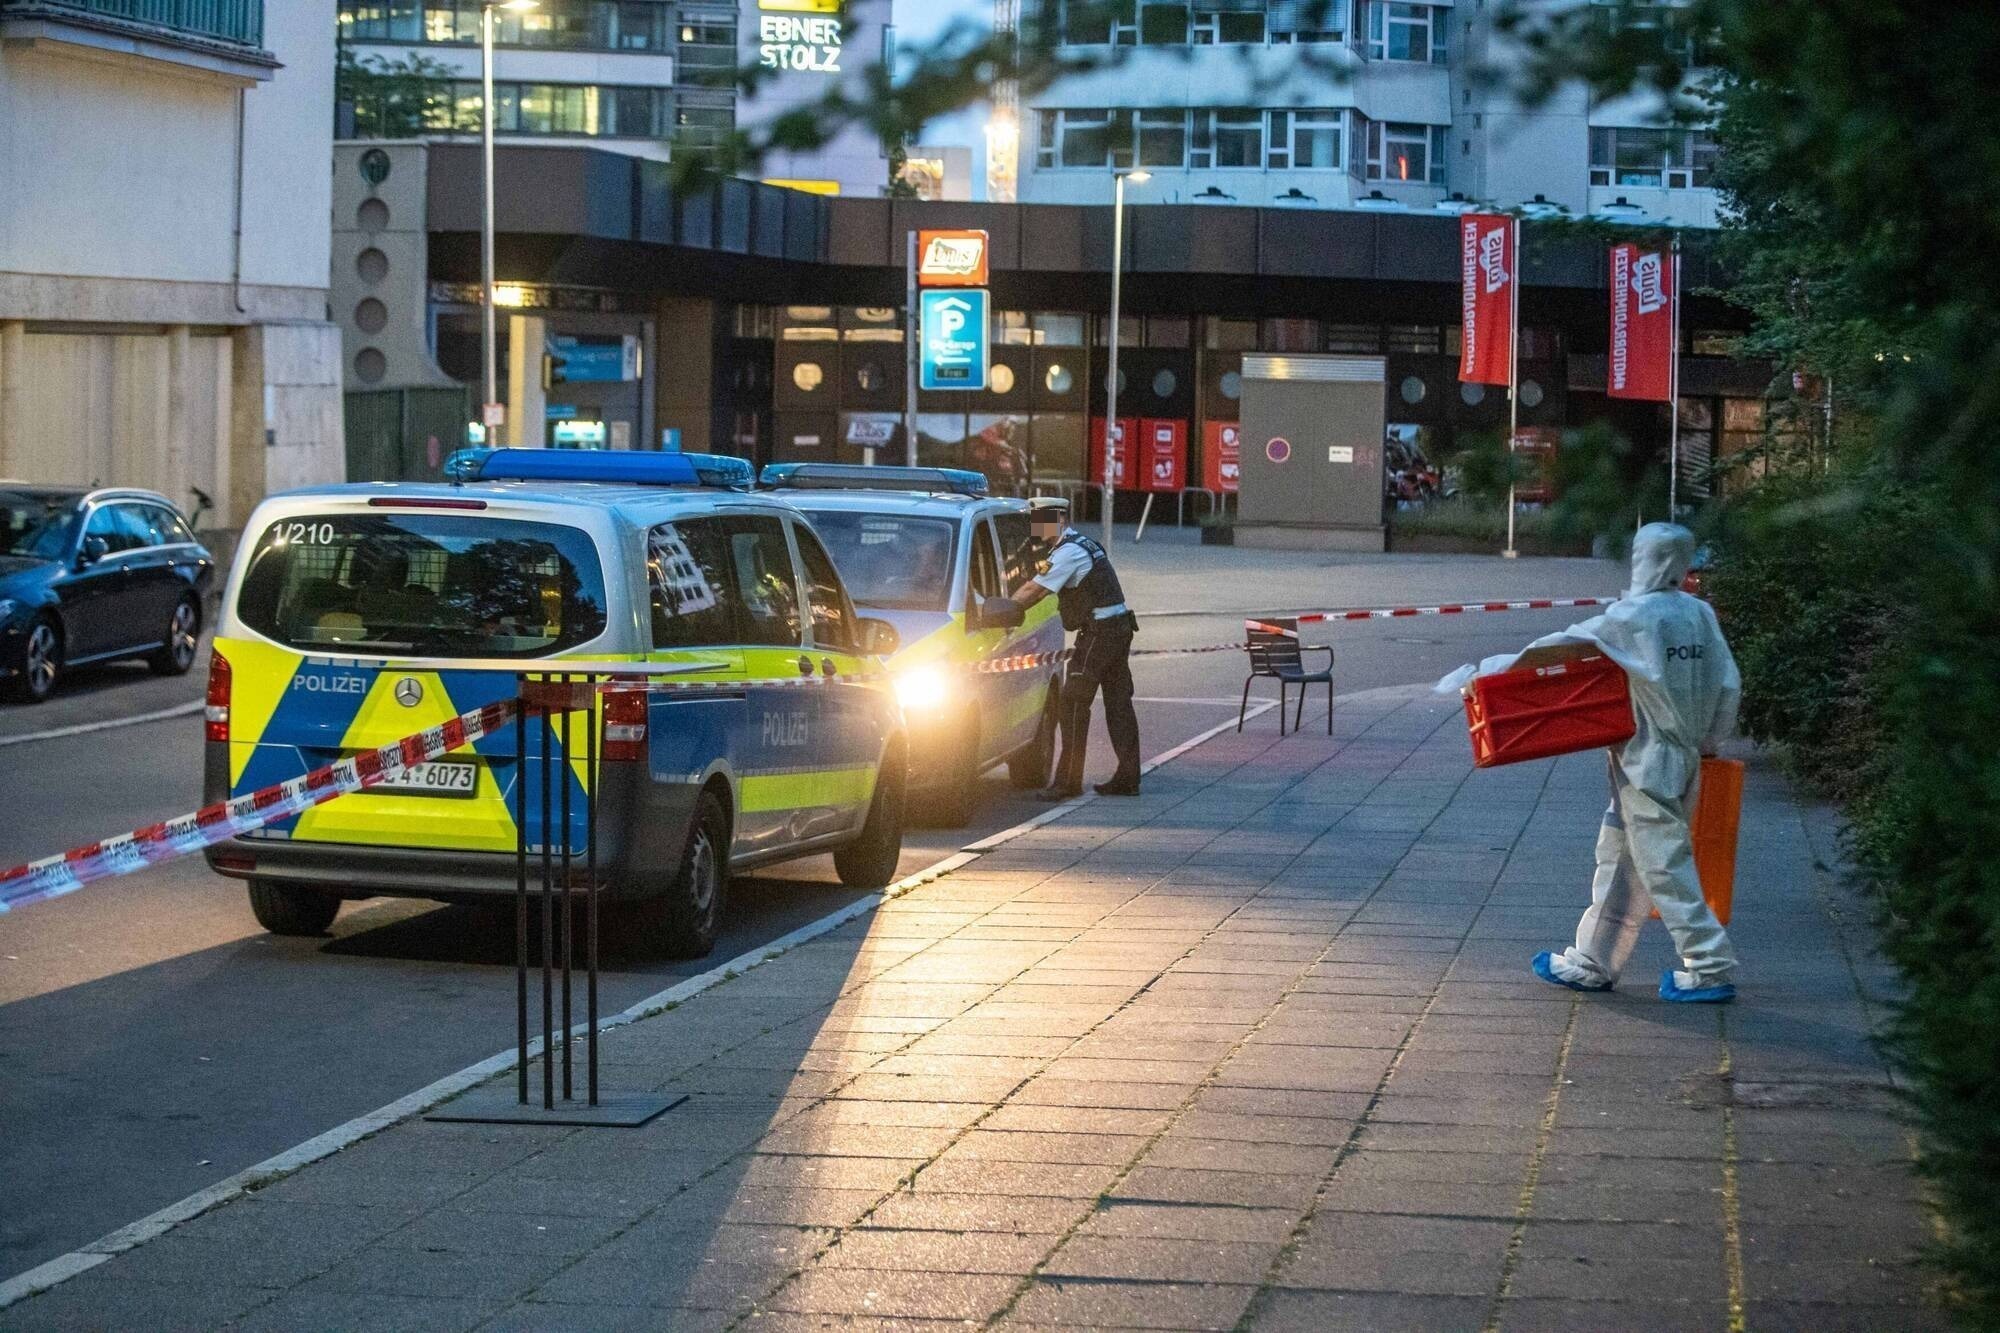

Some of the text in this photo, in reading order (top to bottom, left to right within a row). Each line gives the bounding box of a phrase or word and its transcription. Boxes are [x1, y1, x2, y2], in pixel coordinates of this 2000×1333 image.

[760, 15, 842, 44] EBNER
[760, 44, 841, 72] STOLZ
[272, 523, 334, 546] 1/210
[293, 675, 366, 694] POLIZEI
[763, 711, 808, 746] POLIZEI
[425, 765, 473, 787] 6073
